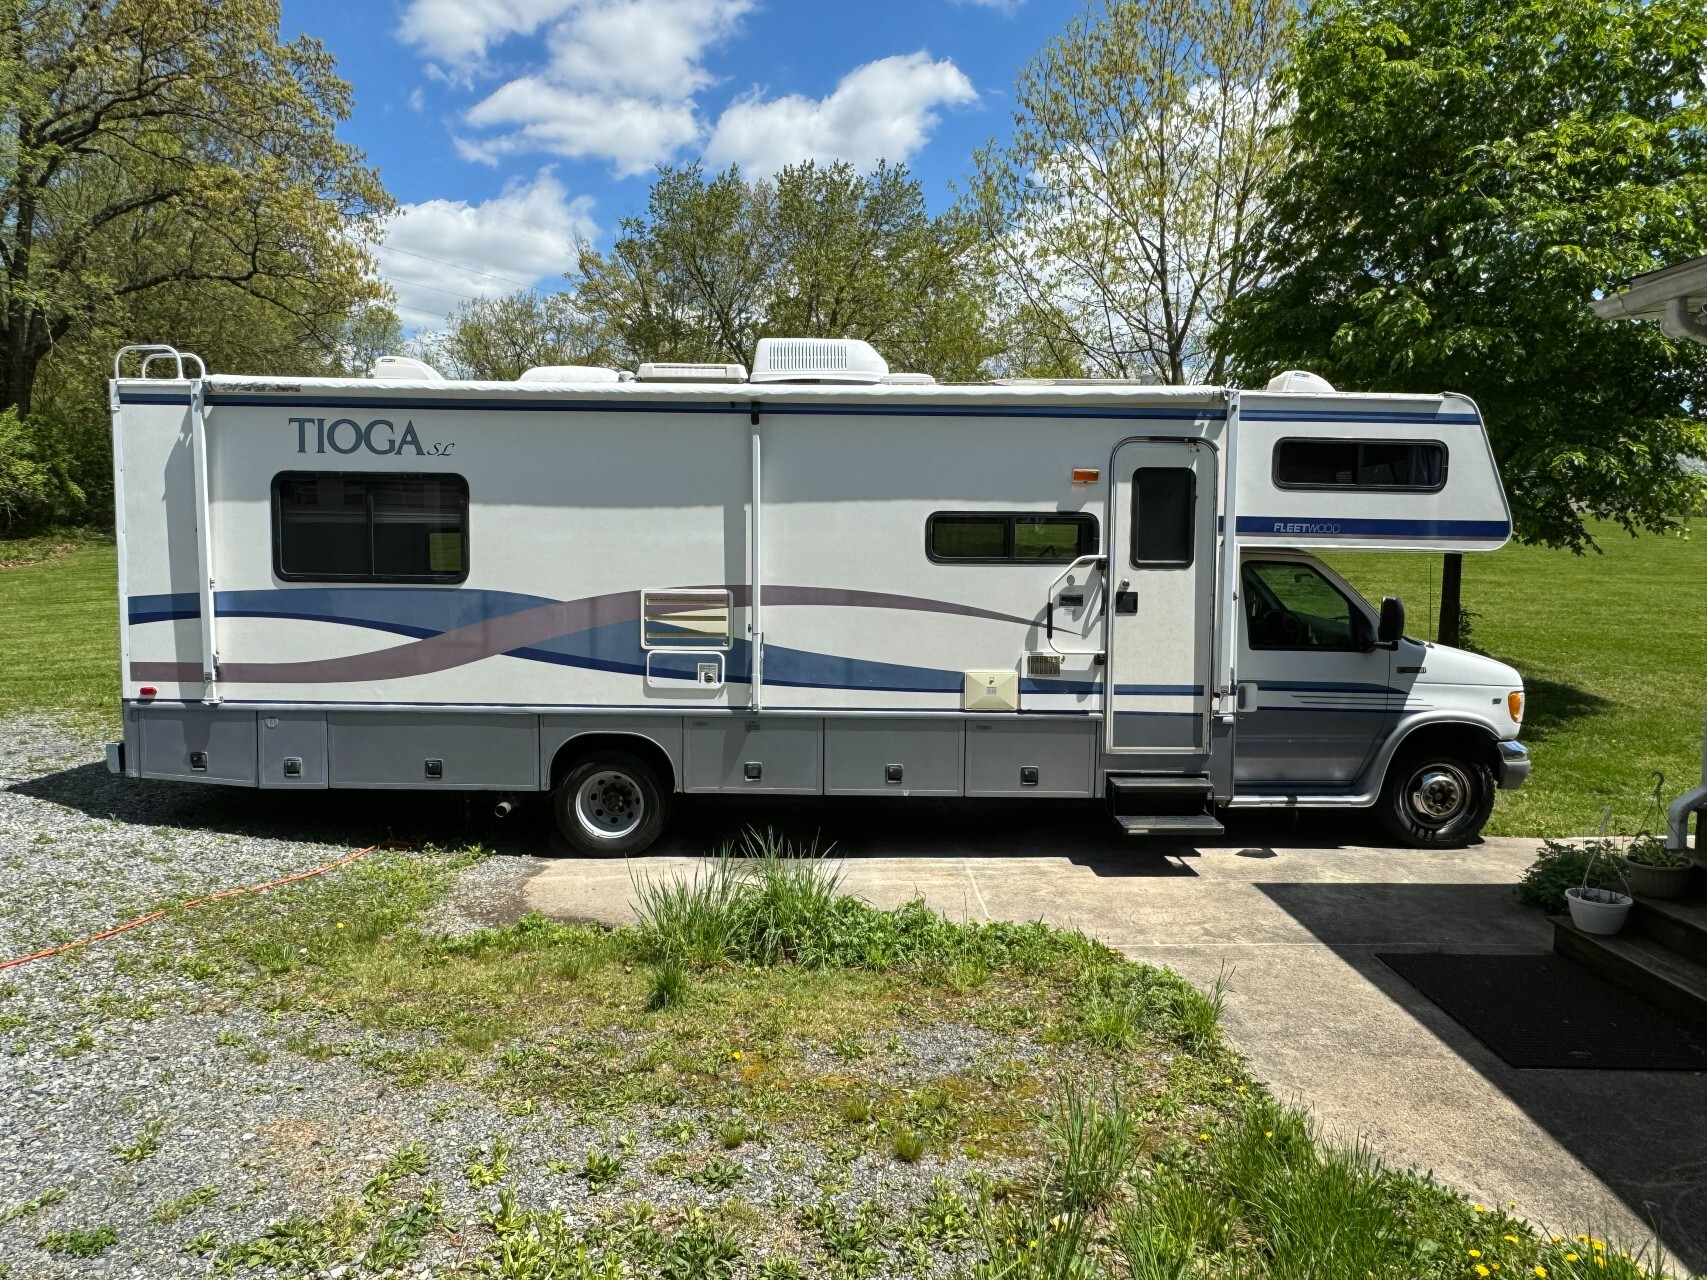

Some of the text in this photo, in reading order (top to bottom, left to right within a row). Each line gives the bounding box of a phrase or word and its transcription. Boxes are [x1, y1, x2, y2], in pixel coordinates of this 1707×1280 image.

[289, 417, 455, 457] TIOGA SL
[1273, 523, 1341, 534] FLEETWOOD
